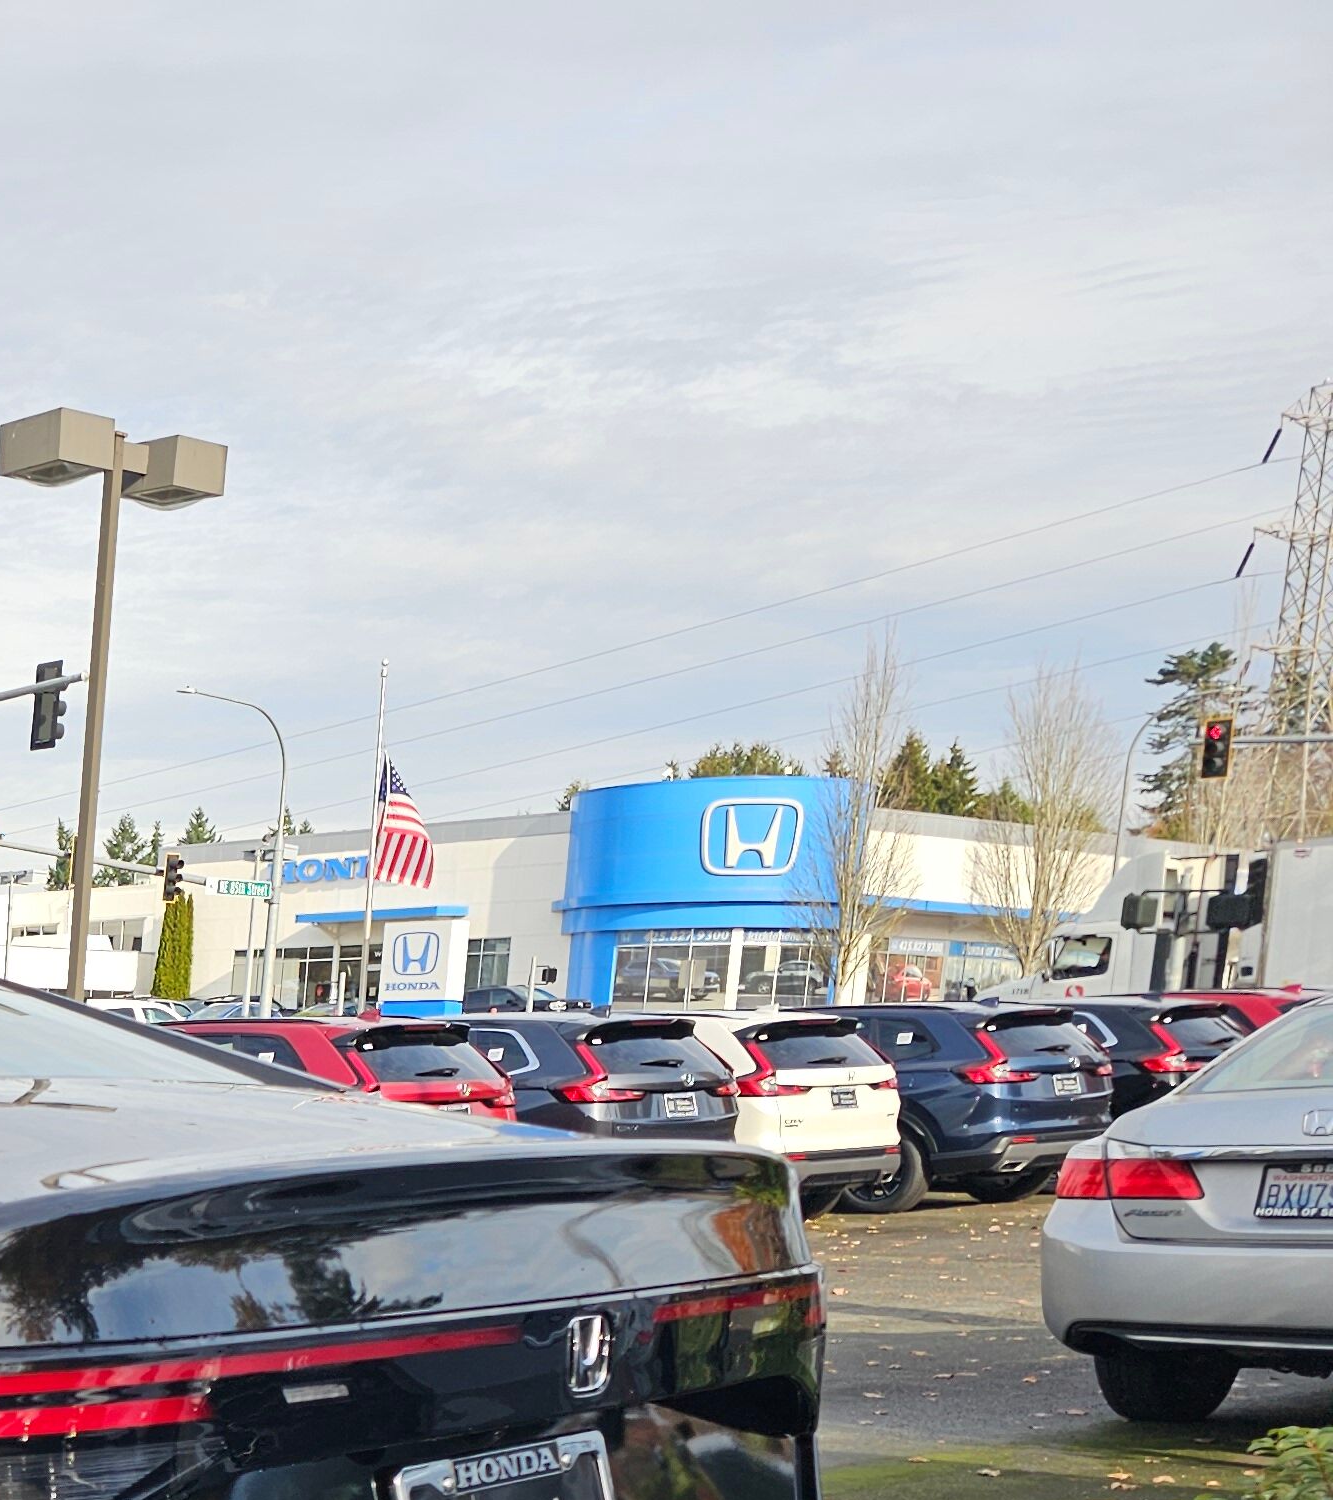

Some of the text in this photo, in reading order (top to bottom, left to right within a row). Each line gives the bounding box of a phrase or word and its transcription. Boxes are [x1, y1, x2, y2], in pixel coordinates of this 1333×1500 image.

[246, 881, 270, 898] Street
[385, 982, 440, 991] HONDA
[1272, 1174, 1333, 1182] WASHINGTO
[1255, 1207, 1298, 1217] HONDA
[1301, 1207, 1319, 1217] OF
[455, 1446, 559, 1489] HONDA
